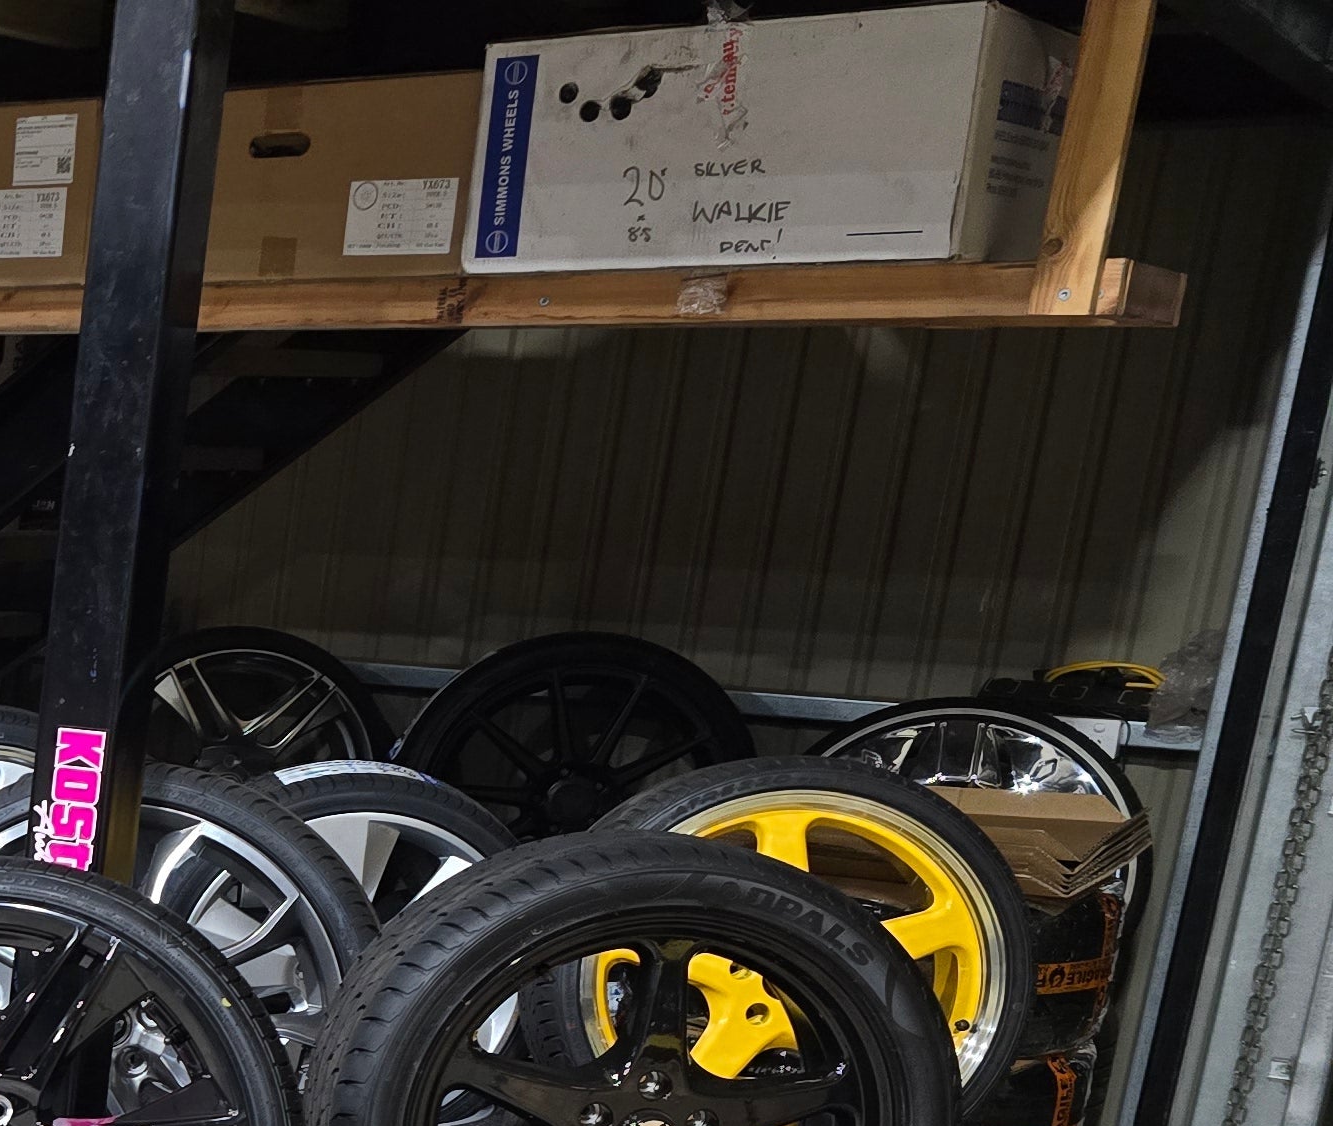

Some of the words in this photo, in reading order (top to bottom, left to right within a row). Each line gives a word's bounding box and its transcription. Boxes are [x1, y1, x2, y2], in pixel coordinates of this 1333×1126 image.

[502, 89, 519, 152] WHEELS
[494, 155, 512, 225] SIMMONS
[692, 200, 791, 223] WALKIE
[748, 886, 874, 967] OPALS
